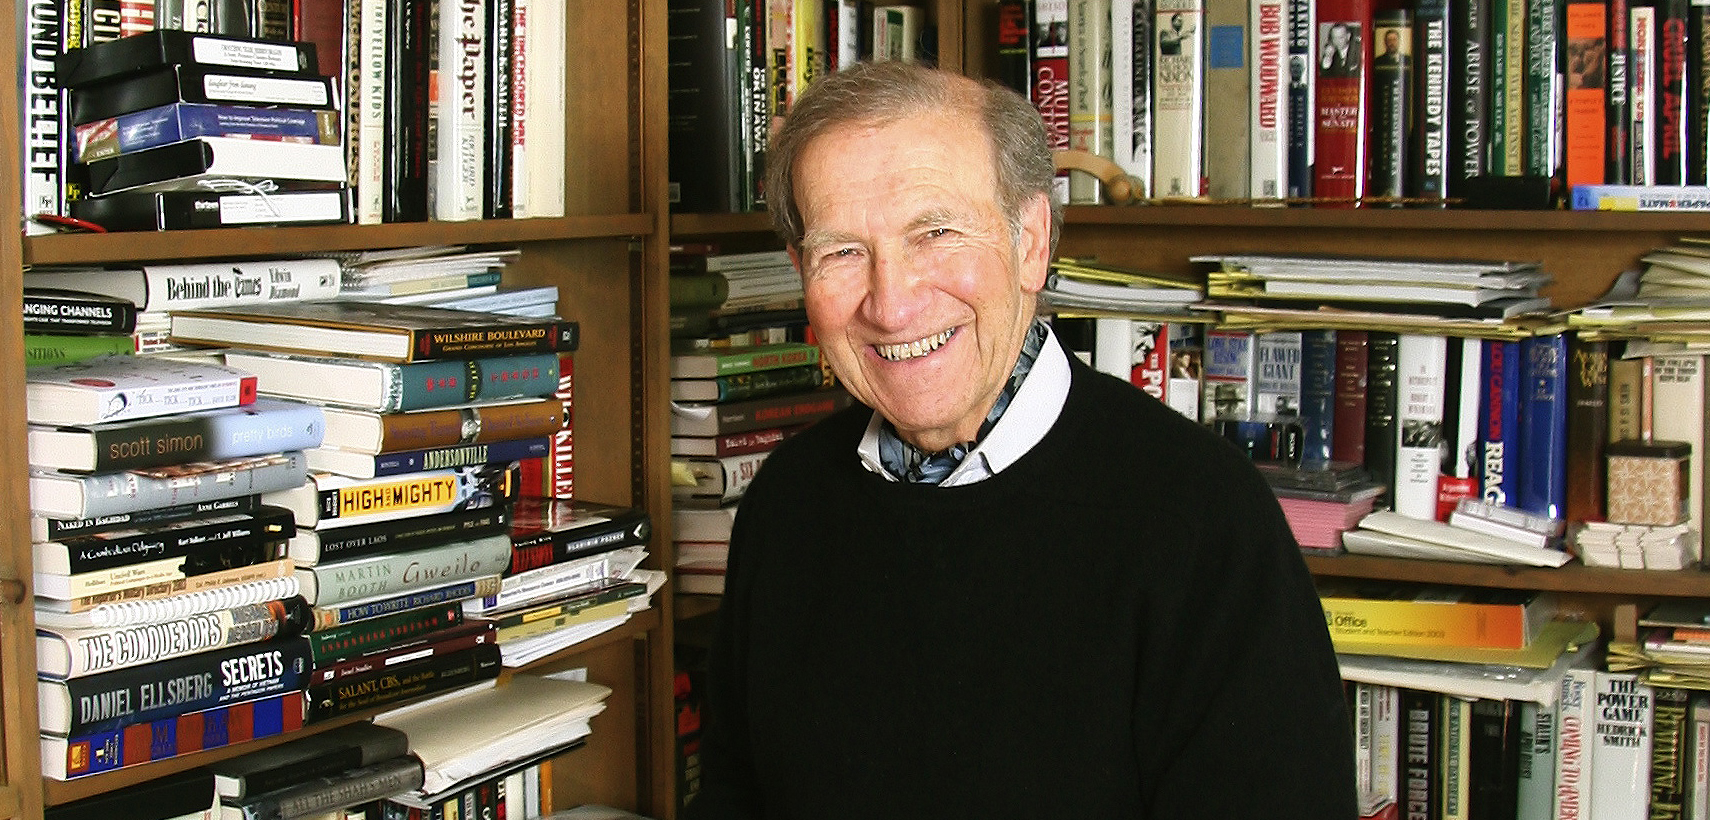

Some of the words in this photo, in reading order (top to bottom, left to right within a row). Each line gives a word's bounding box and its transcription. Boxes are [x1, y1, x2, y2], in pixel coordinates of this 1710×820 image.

[1259, 4, 1281, 36] BOB
[1297, 0, 1309, 47] AKING
[1428, 20, 1444, 48] THE
[371, 29, 384, 80] YELLOW
[1465, 39, 1481, 95] ABUSE
[454, 33, 483, 121] Paper
[1259, 37, 1280, 129] WOODWARD
[1427, 53, 1444, 127] KENNEDY
[1611, 51, 1627, 107] JUSTICE
[371, 86, 383, 120] KIDS
[498, 74, 508, 129] SMITH
[752, 66, 762, 154] OKINAWA
[31, 70, 59, 182] BELIEF
[1426, 130, 1443, 177] TAPES
[1464, 118, 1481, 180] POWER
[166, 275, 210, 301] Behind
[212, 275, 232, 298] the
[60, 305, 113, 319] CHANNELS
[433, 332, 484, 345] WILSHIRE
[487, 327, 546, 341] BOULEVARD
[1260, 345, 1301, 363] FLAWED
[1262, 362, 1295, 379] GIANT
[1488, 374, 1503, 441] CANNON
[110, 436, 151, 460] scott
[156, 433, 204, 454] simon
[231, 427, 264, 445] pretty
[266, 424, 294, 441] birds
[422, 444, 489, 471] ANDERSONVILLE
[343, 487, 385, 513] HIGH
[392, 479, 457, 507] MIGHTY
[57, 519, 84, 531] NAKED
[325, 541, 345, 552] LOST
[346, 538, 367, 549] OVER
[368, 534, 387, 545] LAOS
[335, 564, 392, 583] MARTIN
[402, 553, 481, 585] Gweilo
[338, 580, 388, 599] BOOTH
[347, 606, 370, 619] HOW
[371, 604, 382, 614] TO
[382, 598, 409, 613] WRITE
[1335, 615, 1368, 628] Office
[78, 635, 114, 673] THE
[112, 613, 222, 665] CONQUERORS
[220, 650, 284, 687] SECRETS
[79, 687, 135, 725] DANIEL
[140, 671, 214, 712] ELLSBERG
[1597, 692, 1649, 709] POWER
[1608, 679, 1638, 693] THE
[1602, 707, 1643, 722] GAME
[1408, 709, 1429, 764] BRUTE
[1535, 713, 1553, 754] STALIN'S
[1560, 716, 1582, 765] COMING
[1603, 735, 1641, 747] SMITH
